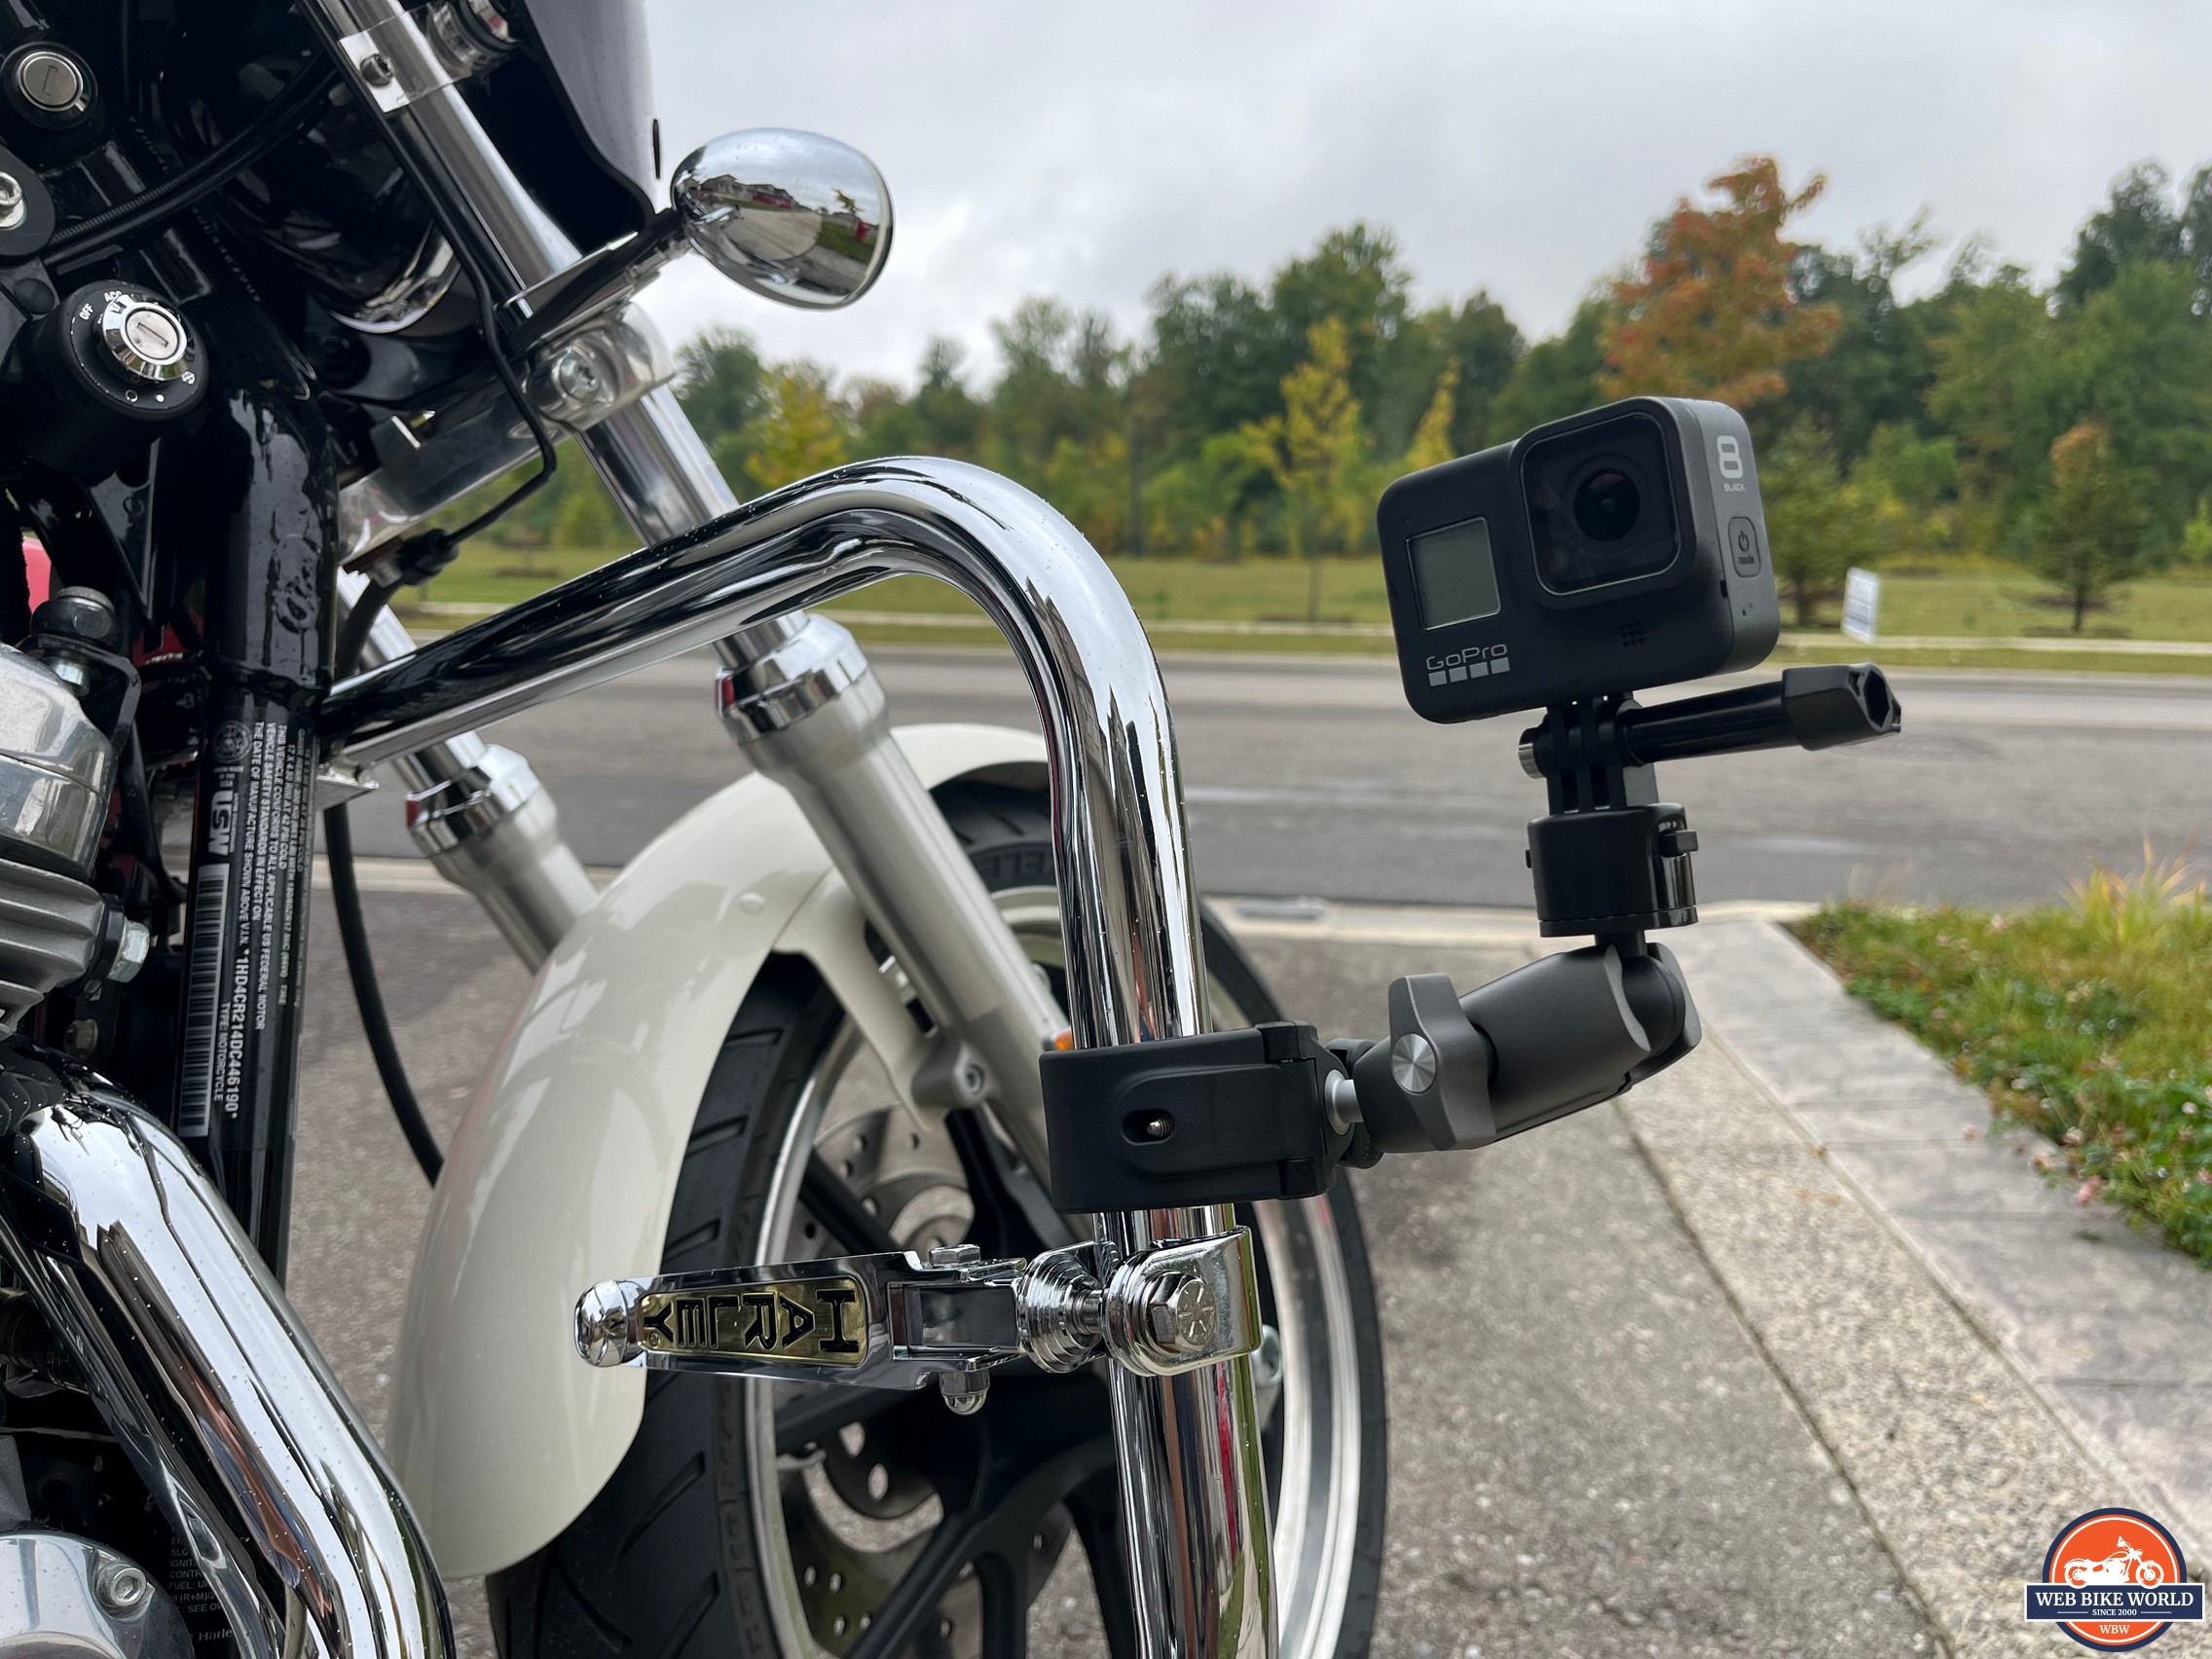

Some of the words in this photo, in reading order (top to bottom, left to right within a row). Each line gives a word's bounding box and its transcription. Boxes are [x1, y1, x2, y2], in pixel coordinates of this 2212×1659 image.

[79, 303, 93, 320] OFF
[1717, 435, 1744, 479] 8
[1724, 483, 1746, 492] BLACK
[1425, 644, 1507, 670] GoPro
[253, 721, 265, 740] THE
[264, 722, 276, 761] VEHICLE
[276, 724, 288, 745] THIS
[251, 740, 263, 765] DATE
[274, 746, 286, 785] VEHICLE
[250, 765, 261, 779] OF
[262, 761, 275, 797] SAFETY
[244, 781, 260, 851] MANUFACTURE
[257, 798, 271, 855] STANDARDS
[270, 786, 283, 839] CONFORMS
[269, 840, 279, 854] TO
[278, 842, 289, 870] COLD
[241, 851, 254, 888] SHOWN
[255, 857, 267, 866] IN
[267, 854, 277, 872] ALL
[253, 867, 266, 904] EFFECT
[240, 888, 251, 921] ABOVE
[251, 905, 263, 921] ON
[263, 873, 276, 932] APPLICABLE
[261, 933, 273, 946] US
[257, 948, 271, 993] FEDERAL
[255, 993, 267, 1030] MOTOR
[214, 1032, 228, 1100] MOTORCYCLE
[170, 1559, 198, 1567] IGNIT
[188, 1604, 207, 1613] SEE
